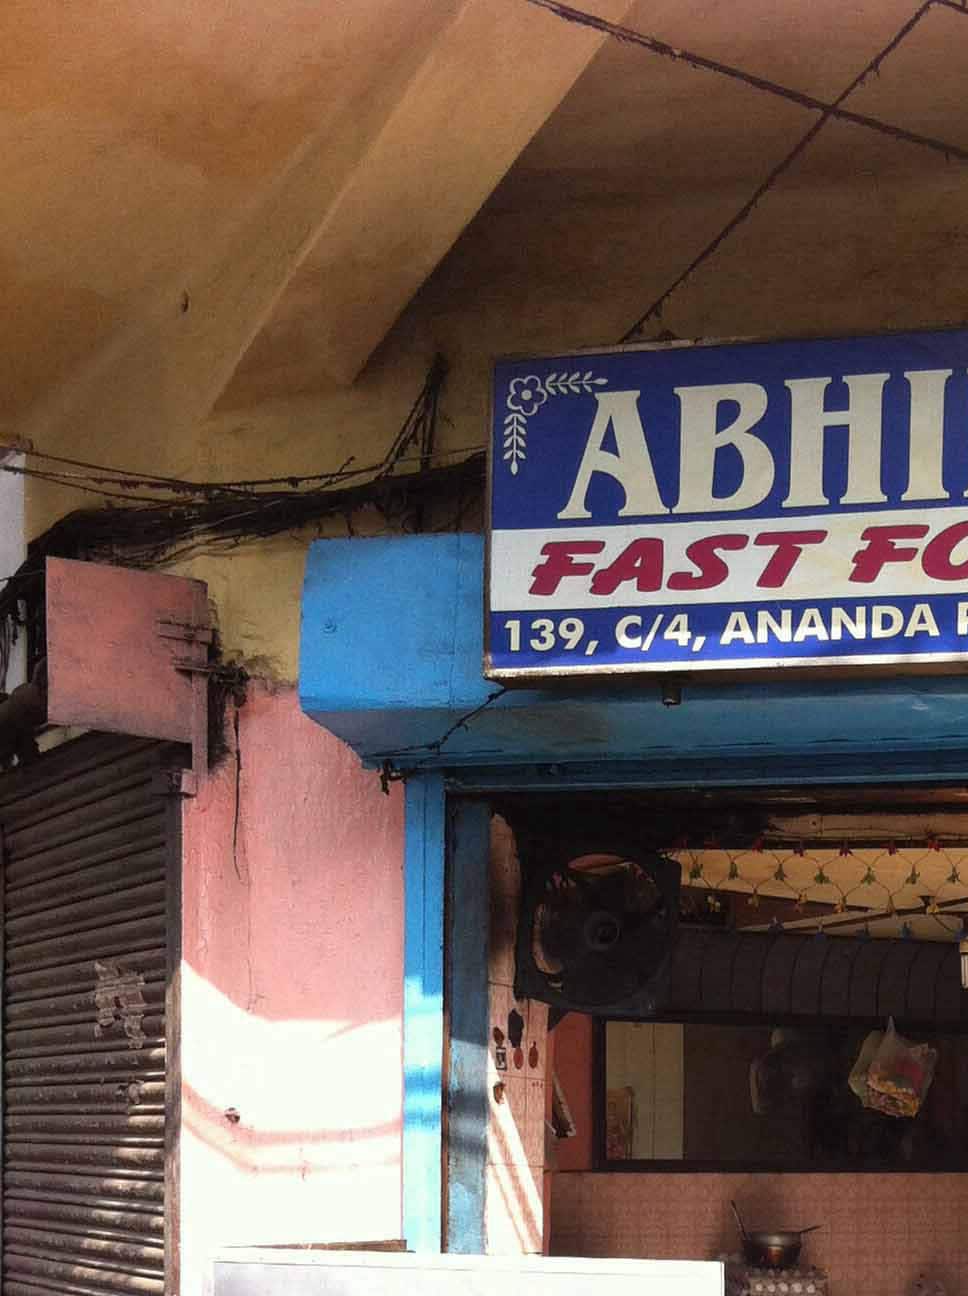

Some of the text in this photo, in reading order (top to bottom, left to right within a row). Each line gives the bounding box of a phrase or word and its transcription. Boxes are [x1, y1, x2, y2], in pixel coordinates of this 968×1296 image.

[528, 529, 828, 597] FAST
[504, 617, 599, 656] 139,
[615, 613, 705, 653] C/4,
[719, 603, 940, 645] ANANDA
